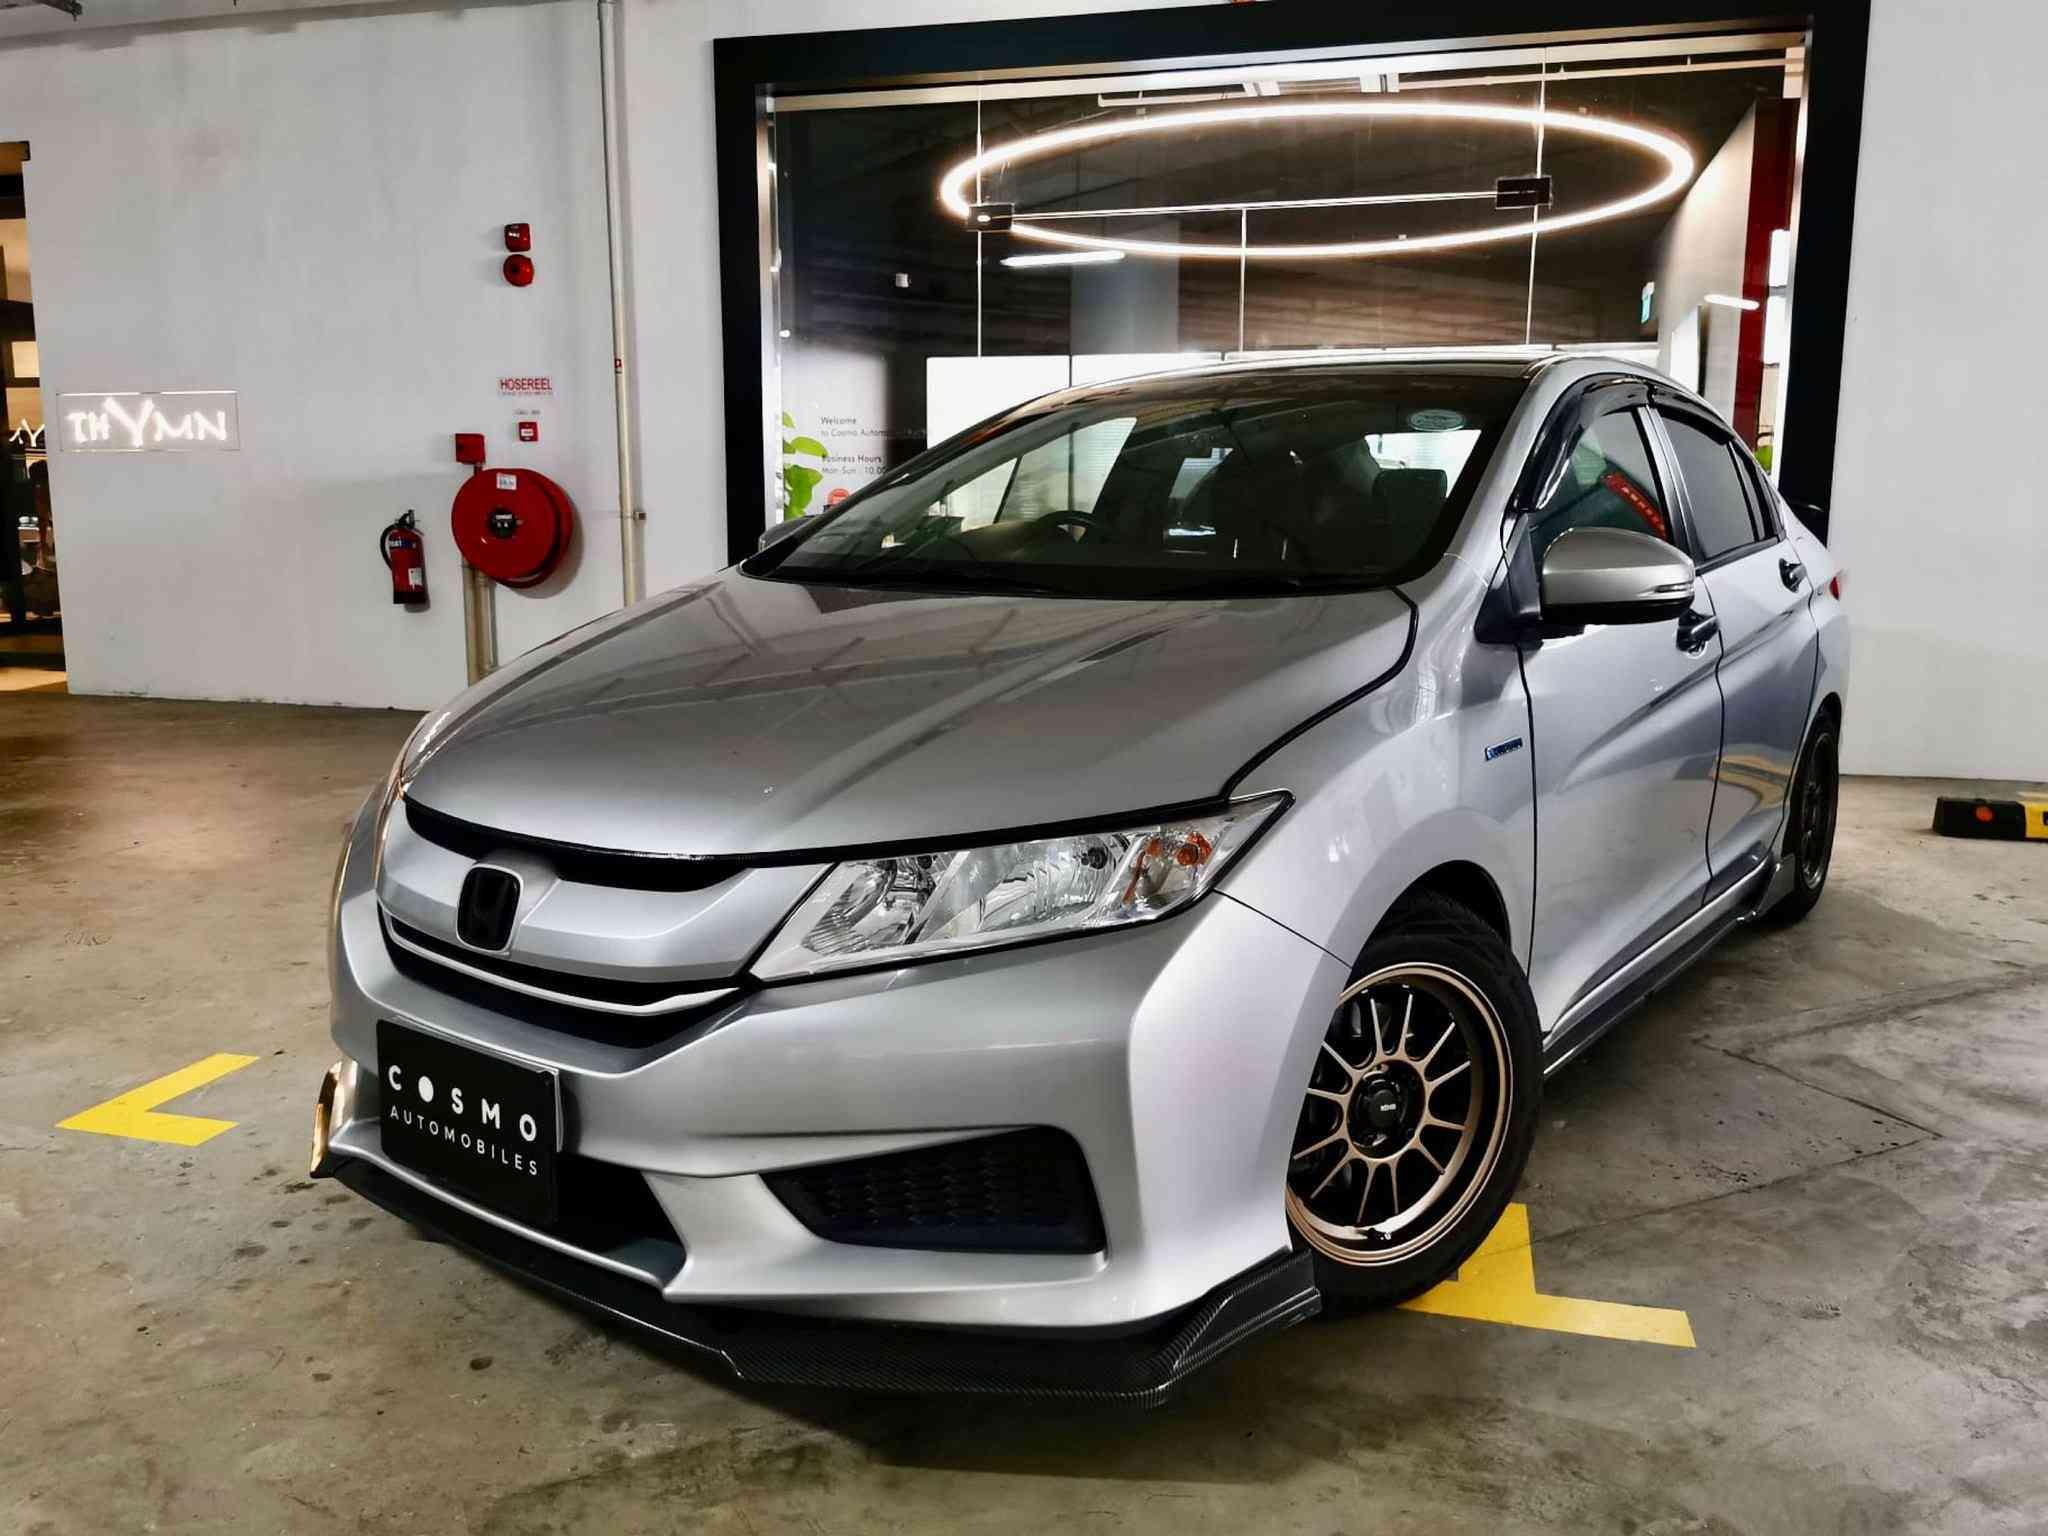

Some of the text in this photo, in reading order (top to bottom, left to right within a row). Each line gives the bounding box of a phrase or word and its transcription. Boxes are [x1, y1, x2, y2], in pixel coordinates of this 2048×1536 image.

[499, 377, 552, 391] HOSEREEL
[66, 396, 228, 447] THYMN
[820, 416, 857, 425] Welcome
[857, 454, 882, 464] Hours
[388, 1064, 537, 1142] COSMO
[390, 1104, 538, 1176] AUTOMOBILES
